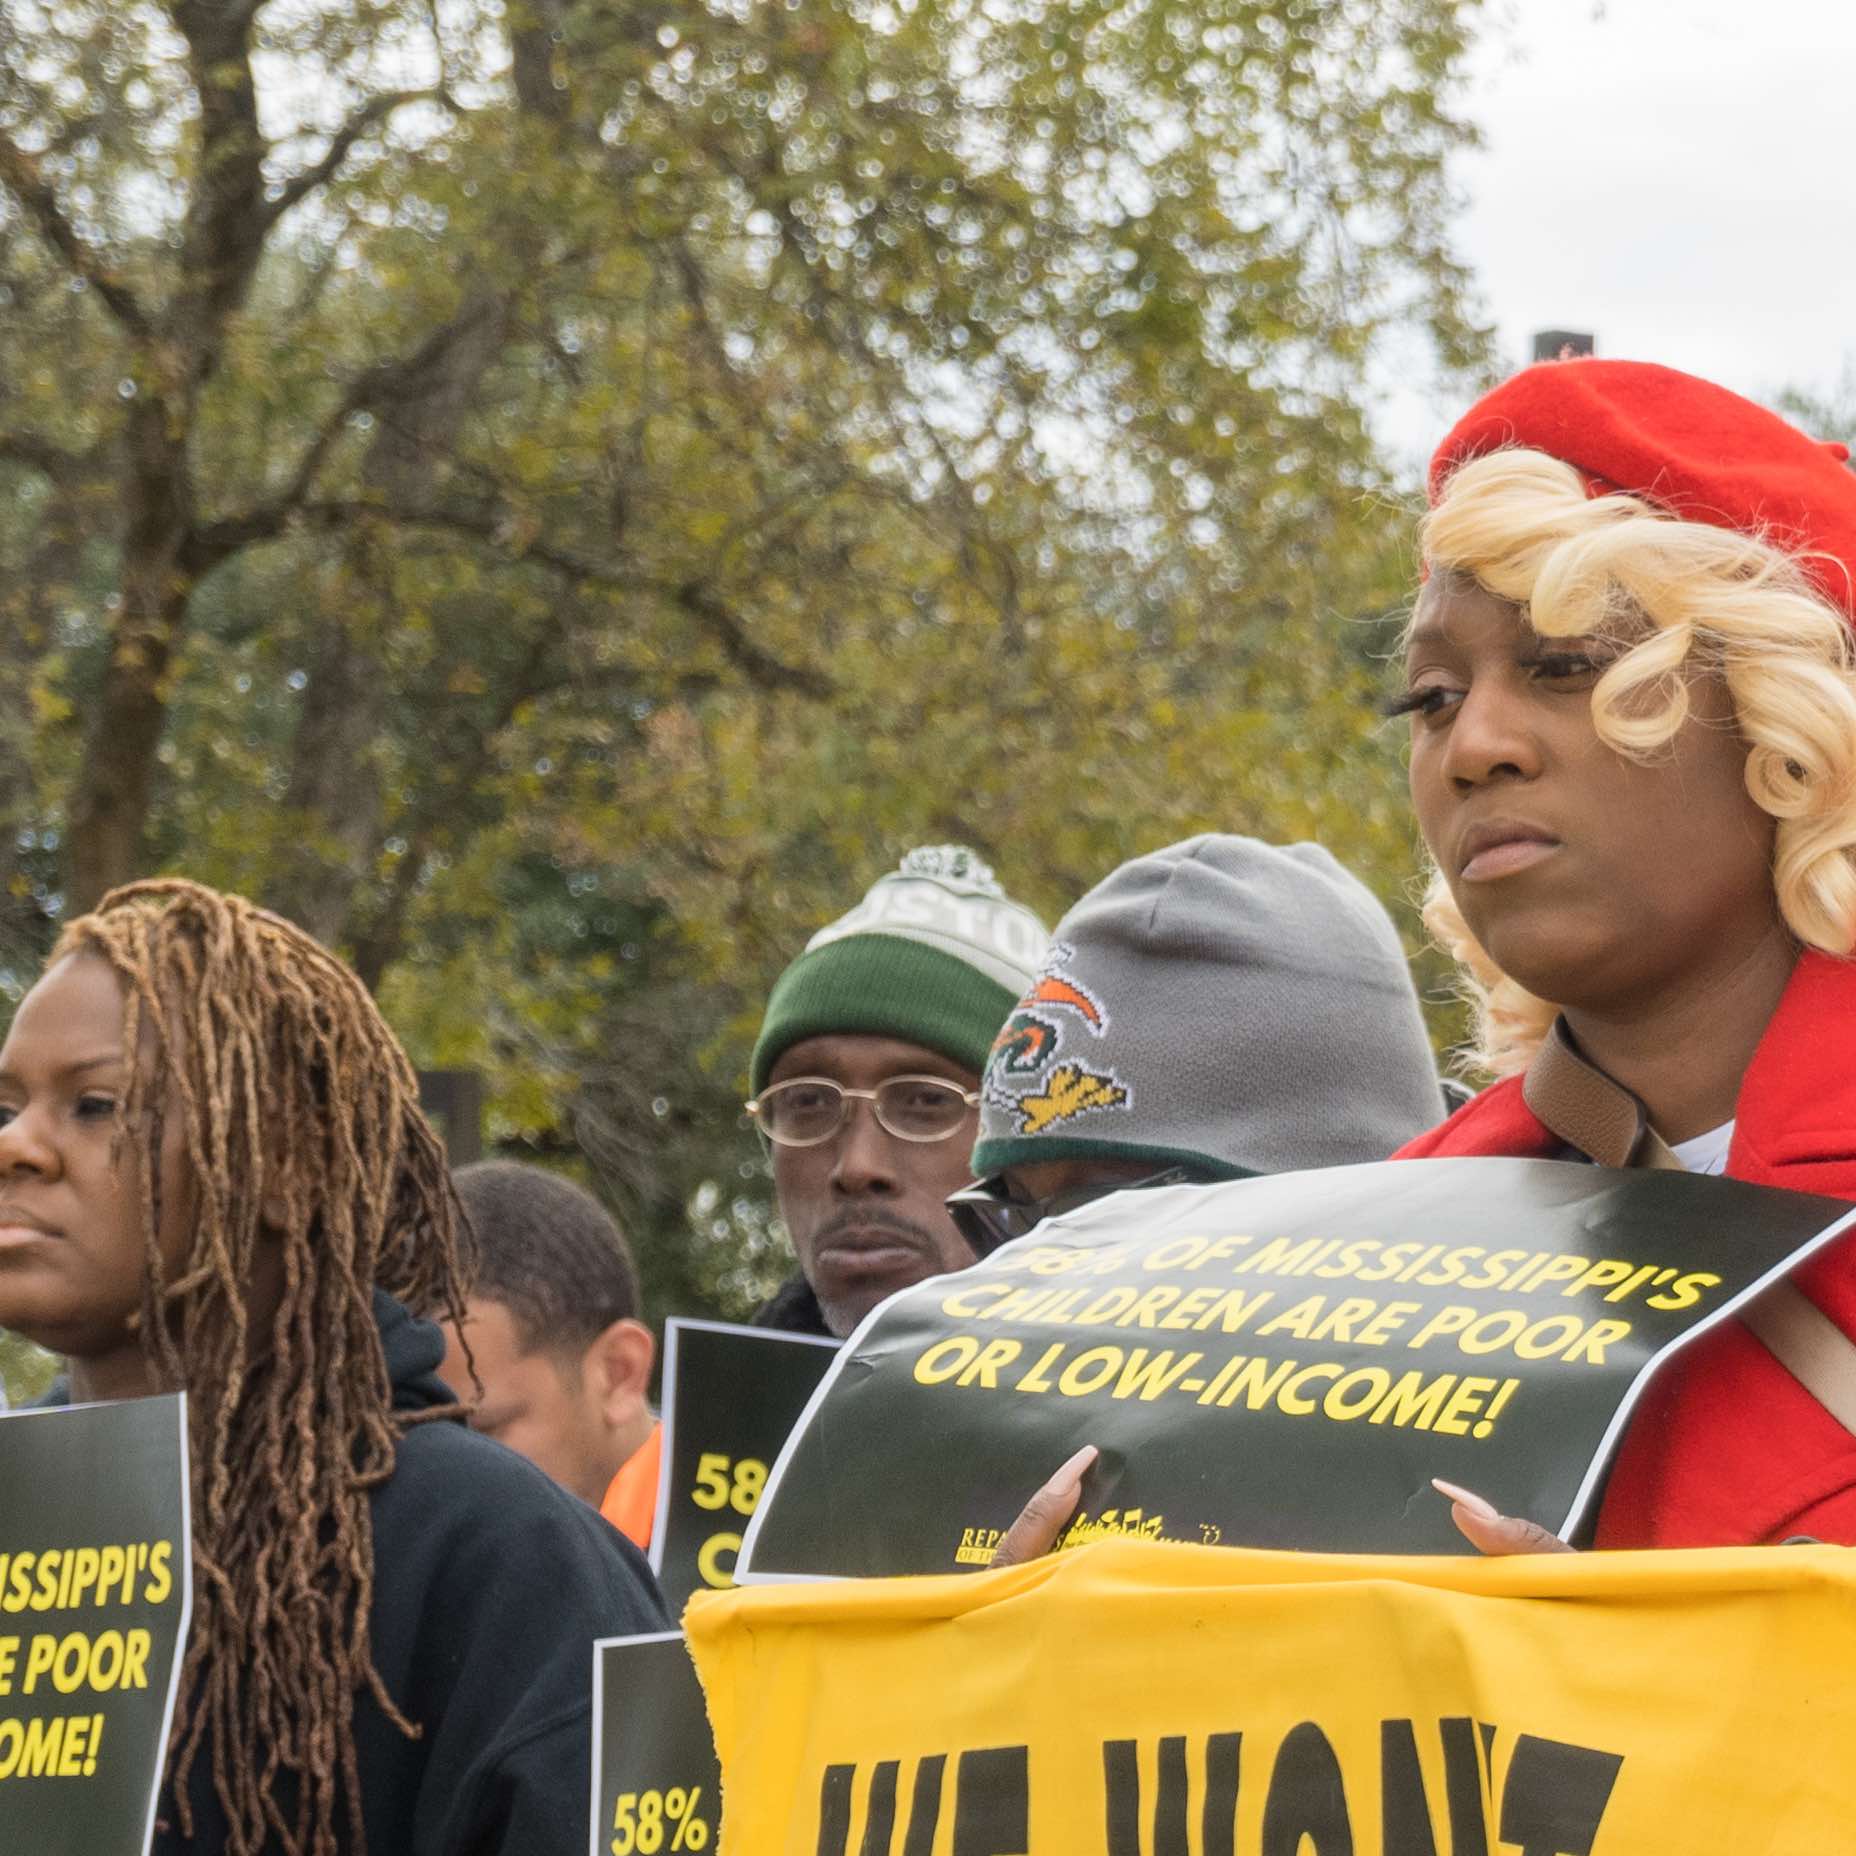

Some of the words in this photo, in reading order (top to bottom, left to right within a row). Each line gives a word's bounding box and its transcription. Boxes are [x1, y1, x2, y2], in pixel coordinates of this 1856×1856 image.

[1141, 1236, 1254, 1273] OF
[1233, 1236, 1722, 1313] MISSISSIPPI'S
[941, 1283, 1276, 1334] CHILDREN
[1254, 1290, 1407, 1348] ARE
[1427, 1304, 1634, 1367] POOR
[912, 1336, 1023, 1389] OR
[1015, 1342, 1521, 1441] LOW-INCOME!
[22, 1628, 151, 1695] POOR
